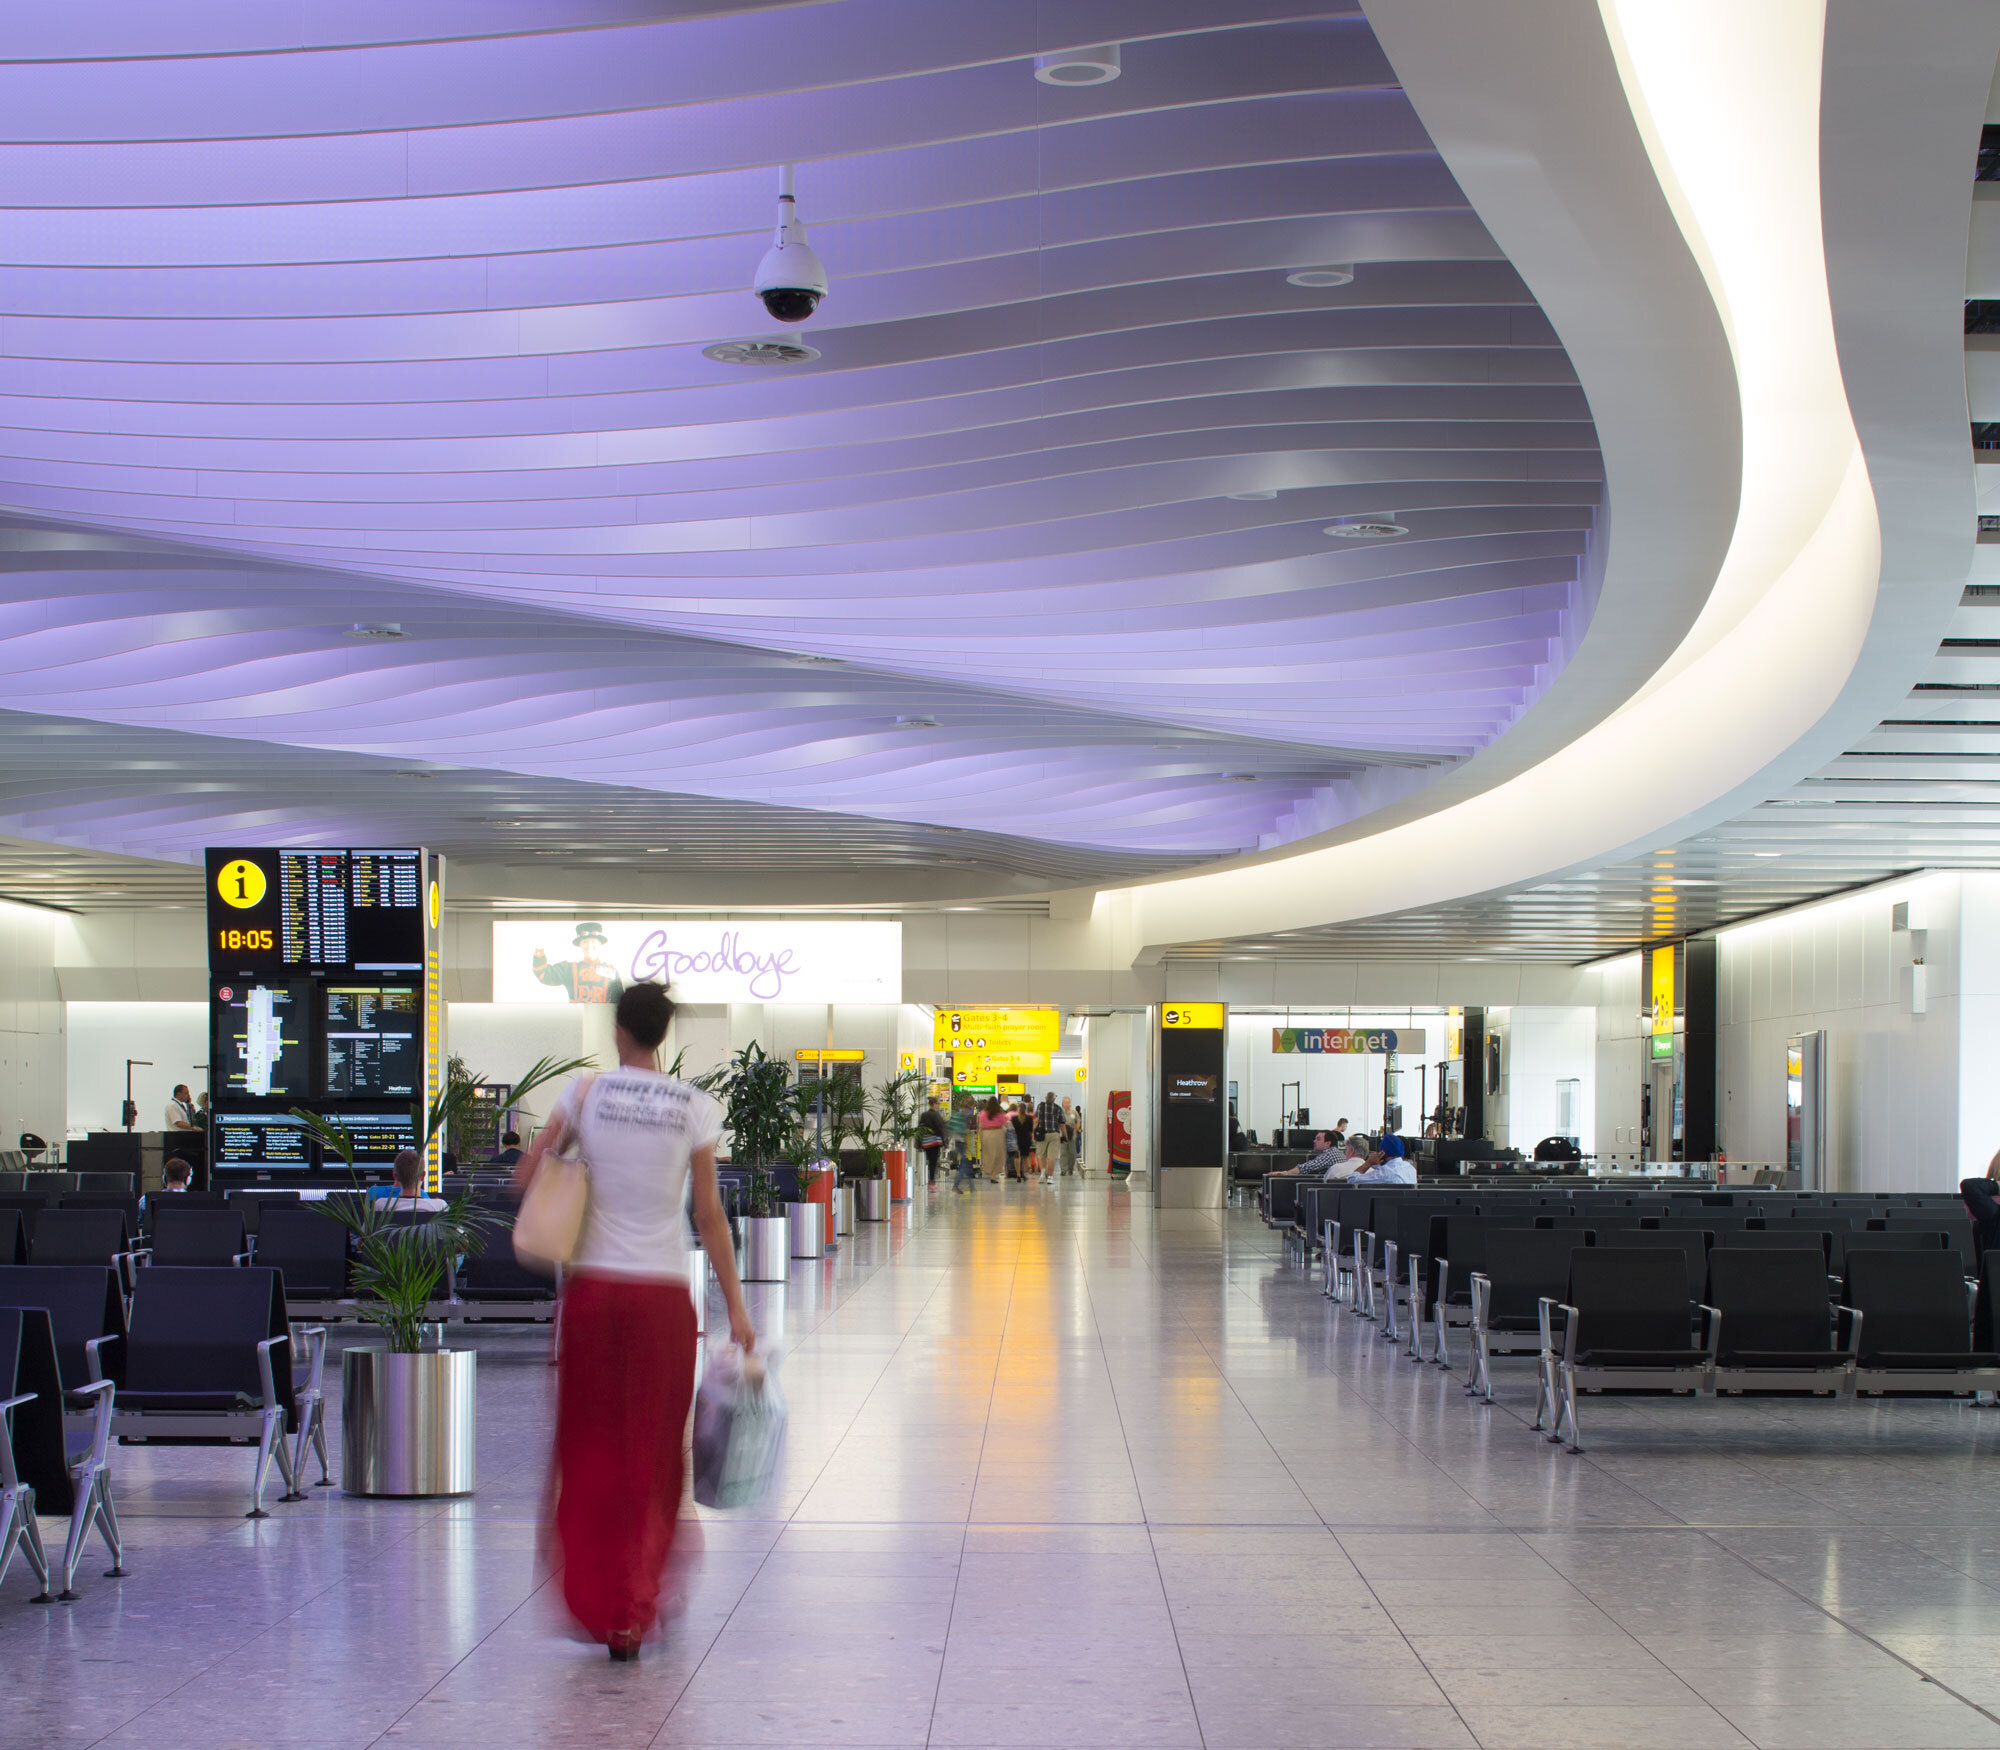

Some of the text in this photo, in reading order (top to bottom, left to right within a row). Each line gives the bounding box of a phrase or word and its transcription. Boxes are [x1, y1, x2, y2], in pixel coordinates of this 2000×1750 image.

[220, 930, 273, 949] 18:05
[630, 929, 802, 1000] Goodbye
[963, 1014, 990, 1022] Gates
[1182, 1011, 1192, 1025] 5
[1003, 1024, 1025, 1032] prayer
[1304, 1031, 1388, 1049] internet
[1176, 1079, 1208, 1087] Heathrow
